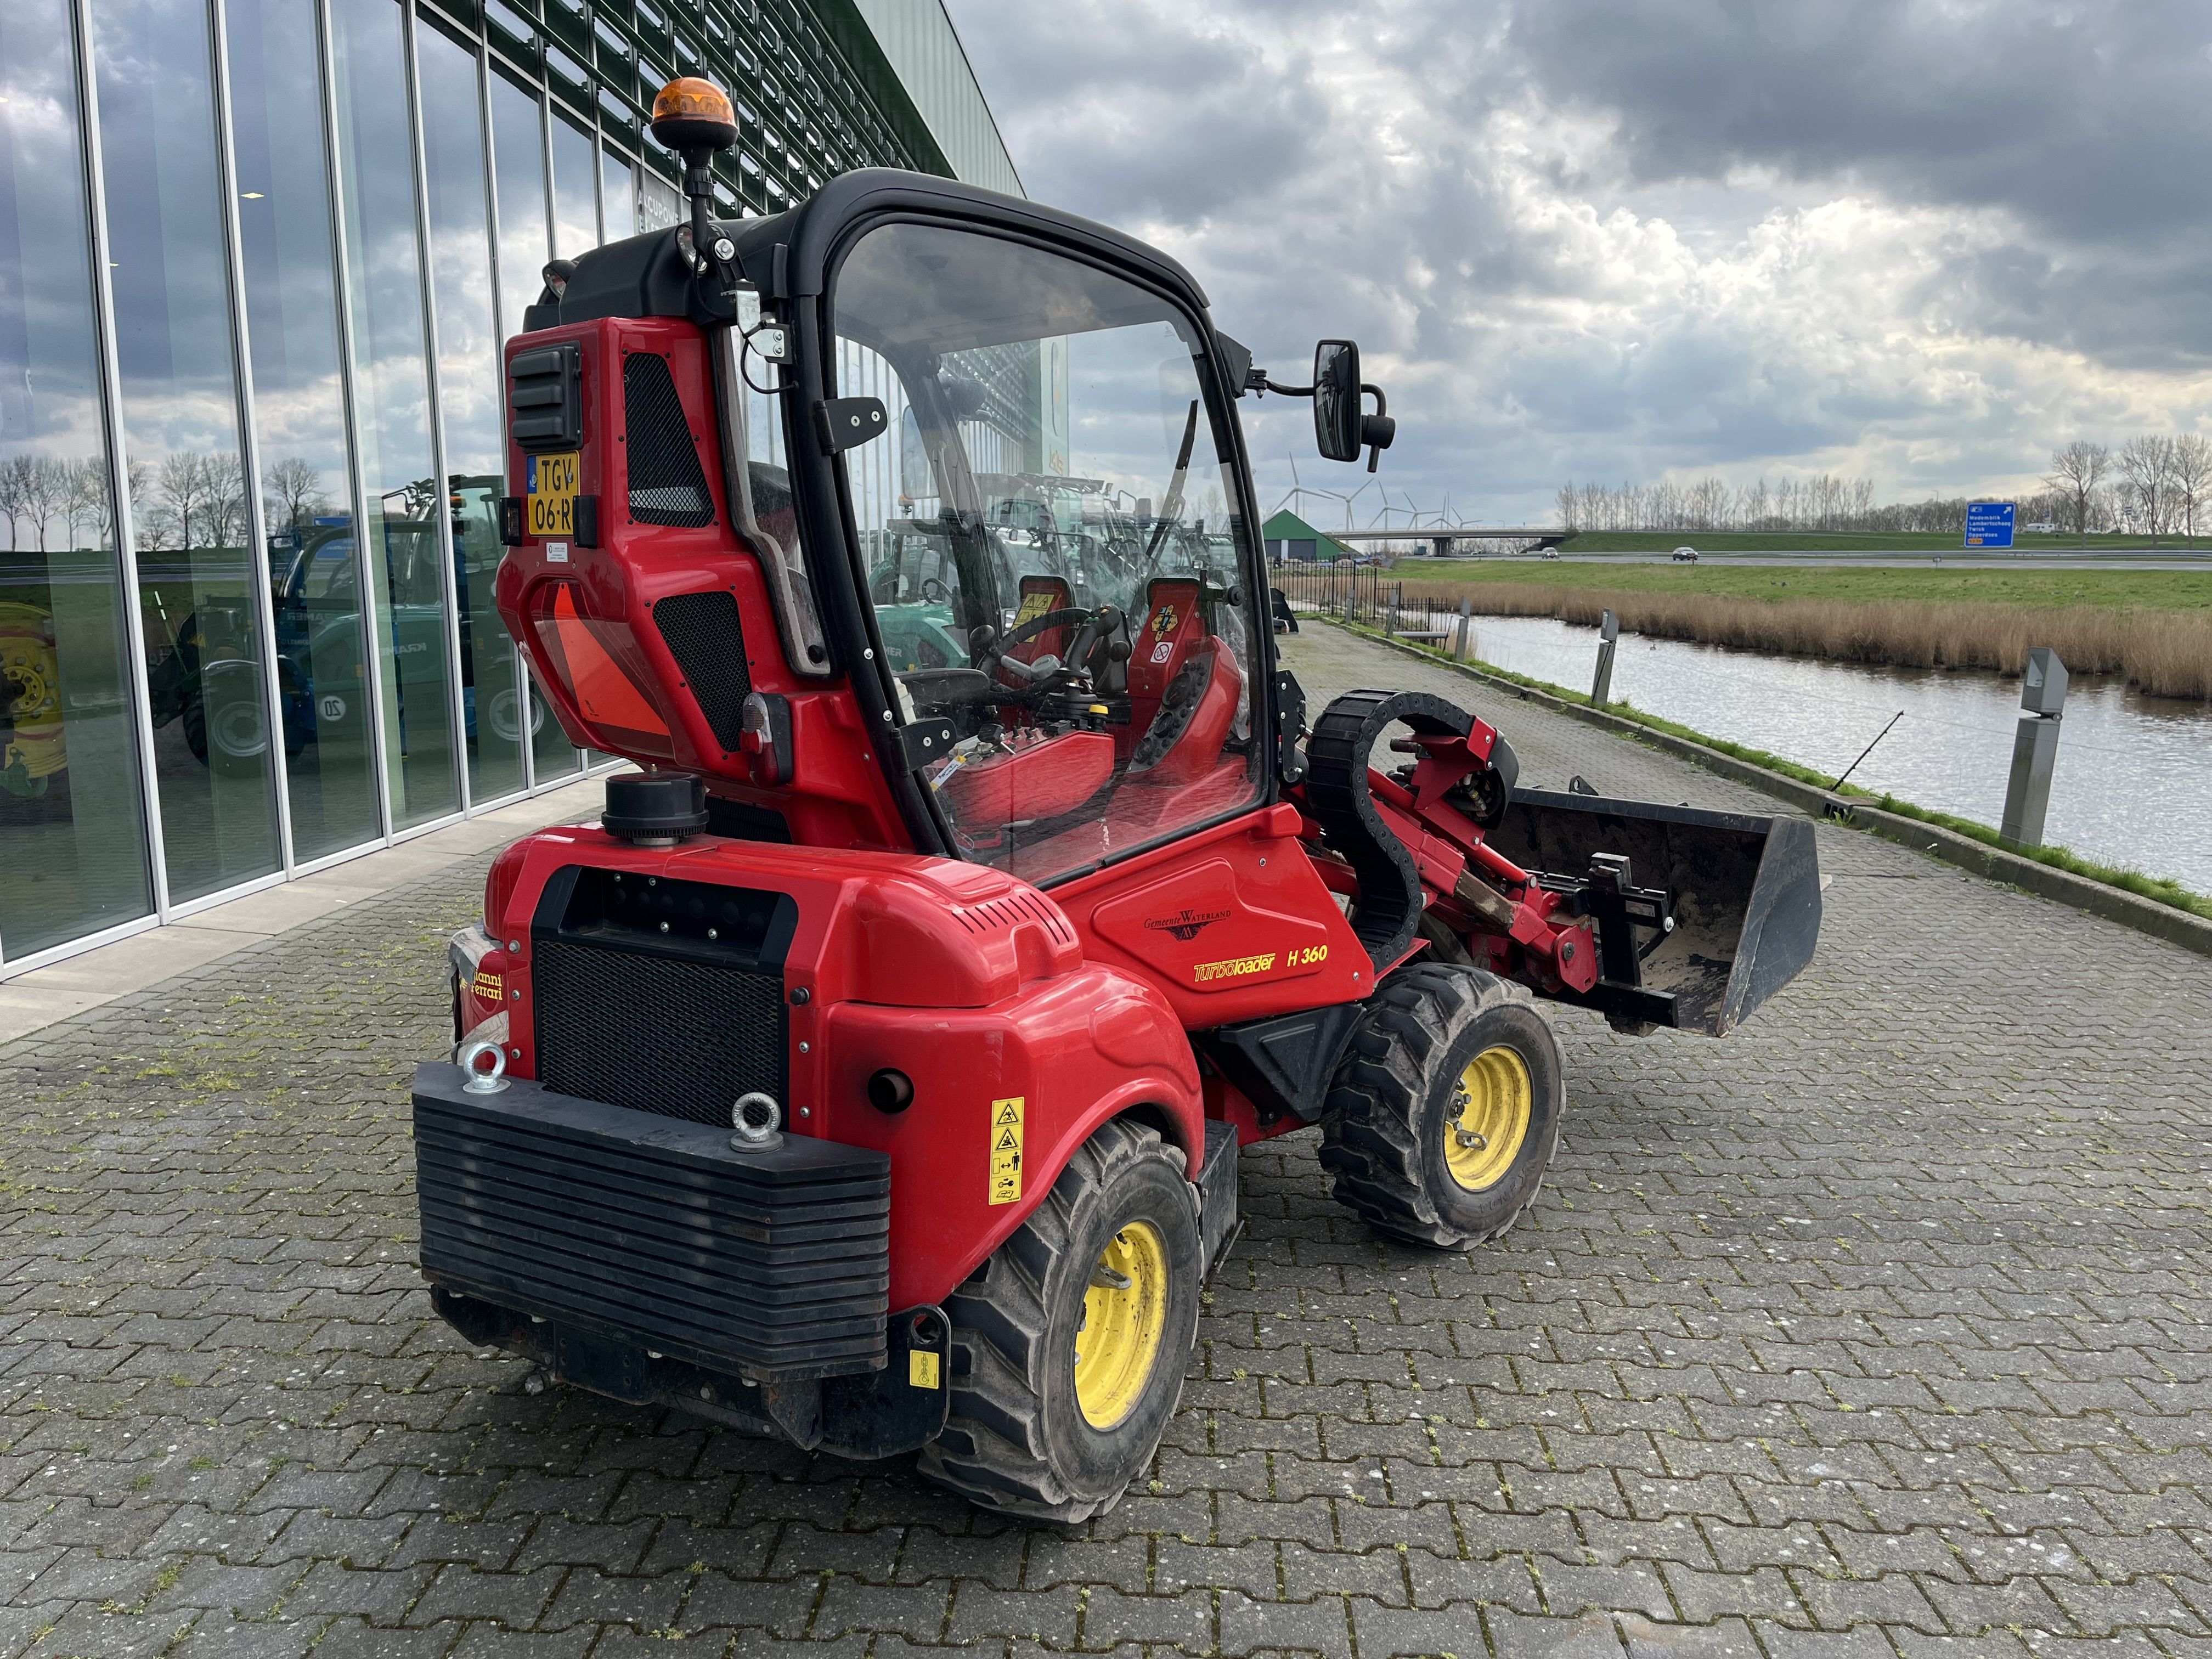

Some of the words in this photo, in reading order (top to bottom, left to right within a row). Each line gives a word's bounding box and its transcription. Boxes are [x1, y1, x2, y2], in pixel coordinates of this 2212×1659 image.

[541, 458, 572, 491] TGV
[1144, 916, 1181, 929] Gemeente
[1180, 909, 1232, 924] WATERLAND
[1193, 952, 1276, 982] Turboloader
[1287, 951, 1299, 967] H
[1301, 945, 1328, 964] 360
[475, 969, 502, 987] ianni
